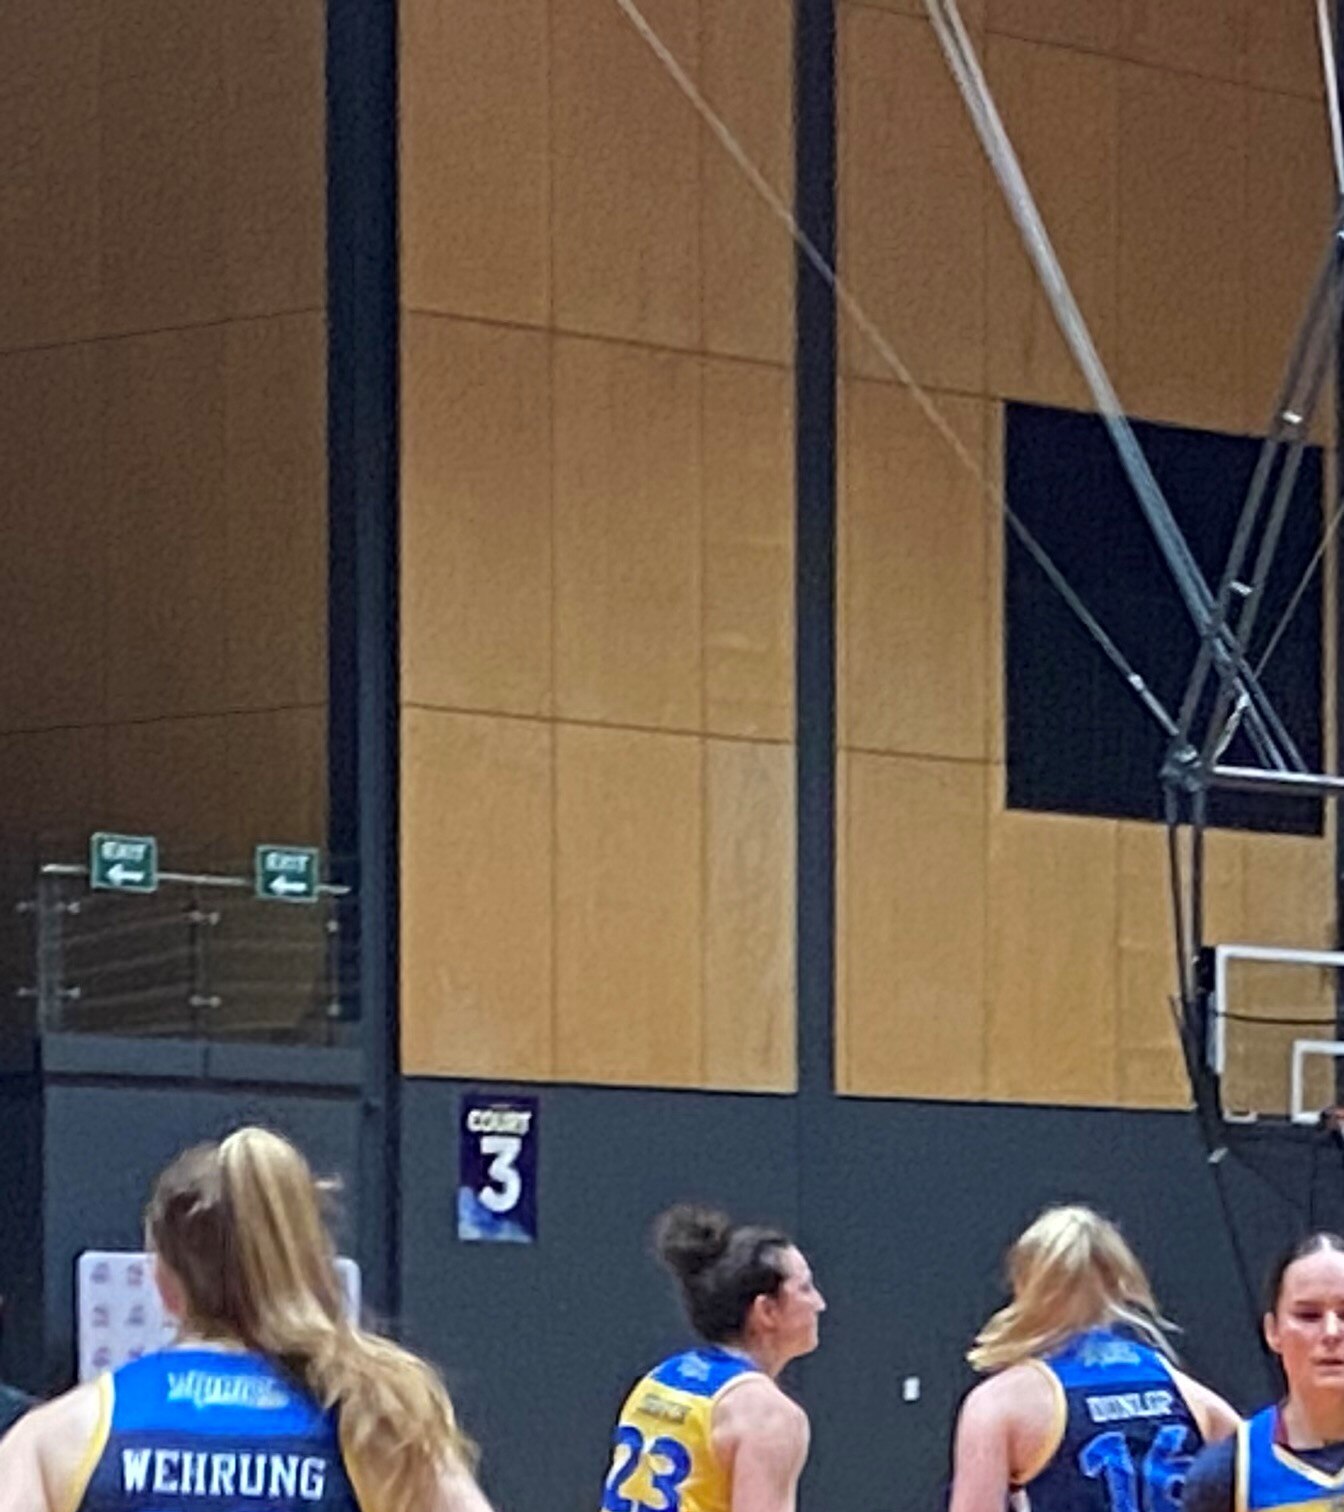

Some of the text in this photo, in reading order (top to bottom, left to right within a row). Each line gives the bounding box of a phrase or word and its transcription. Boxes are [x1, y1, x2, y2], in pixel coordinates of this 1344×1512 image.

[101, 841, 147, 861] EXIT
[265, 852, 309, 873] EXIT
[467, 1109, 532, 1135] COURT
[480, 1135, 522, 1213] 3
[122, 1449, 326, 1500] WEHRUNG
